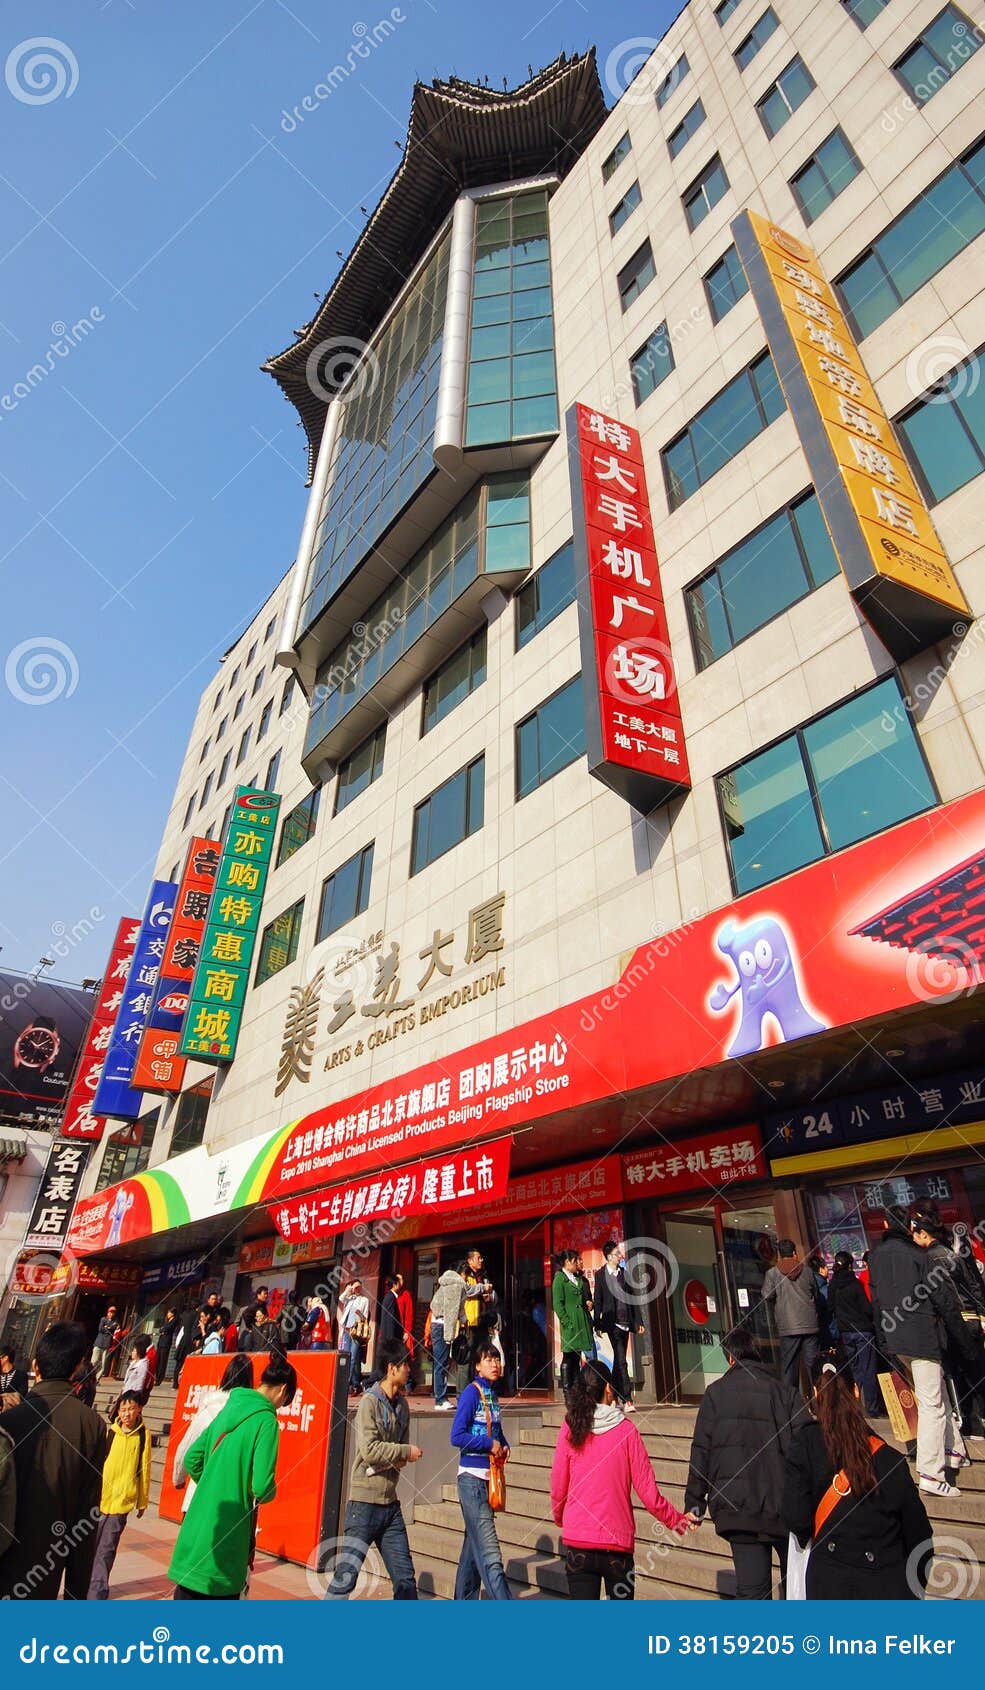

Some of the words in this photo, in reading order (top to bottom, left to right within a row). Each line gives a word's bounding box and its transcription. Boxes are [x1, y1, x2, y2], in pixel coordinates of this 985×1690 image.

[590, 412, 666, 701] 特大手机广场
[612, 711, 678, 744] 工美大厦
[614, 732, 681, 766] 地下一层
[193, 831, 265, 1041] 亦购特惠商城
[165, 996, 188, 1011] DQ
[322, 1046, 351, 1072] ARTS
[353, 1039, 365, 1057] &
[367, 1013, 416, 1050] CRAFTS
[419, 966, 506, 1025] EMPORIUM
[280, 1168, 296, 1181] Expo
[296, 1159, 312, 1176] 2010
[312, 1148, 344, 1170] Shanghai
[344, 1142, 367, 1159] China
[367, 1127, 404, 1151] Licensed
[405, 1115, 446, 1139] Products
[447, 1103, 483, 1124] Beijing
[485, 1085, 533, 1113] Flagship
[535, 1074, 570, 1096] Store
[283, 1077, 451, 1164] 上海世博会特许商品北京旗舰店
[459, 1033, 568, 1101] 团购展示中心
[802, 1111, 834, 1139] 24
[850, 1080, 985, 1128] 小时营业
[33, 1147, 84, 1234] 名表店
[626, 1140, 756, 1184] 特大手机卖场
[863, 1177, 950, 1209] 甜品站
